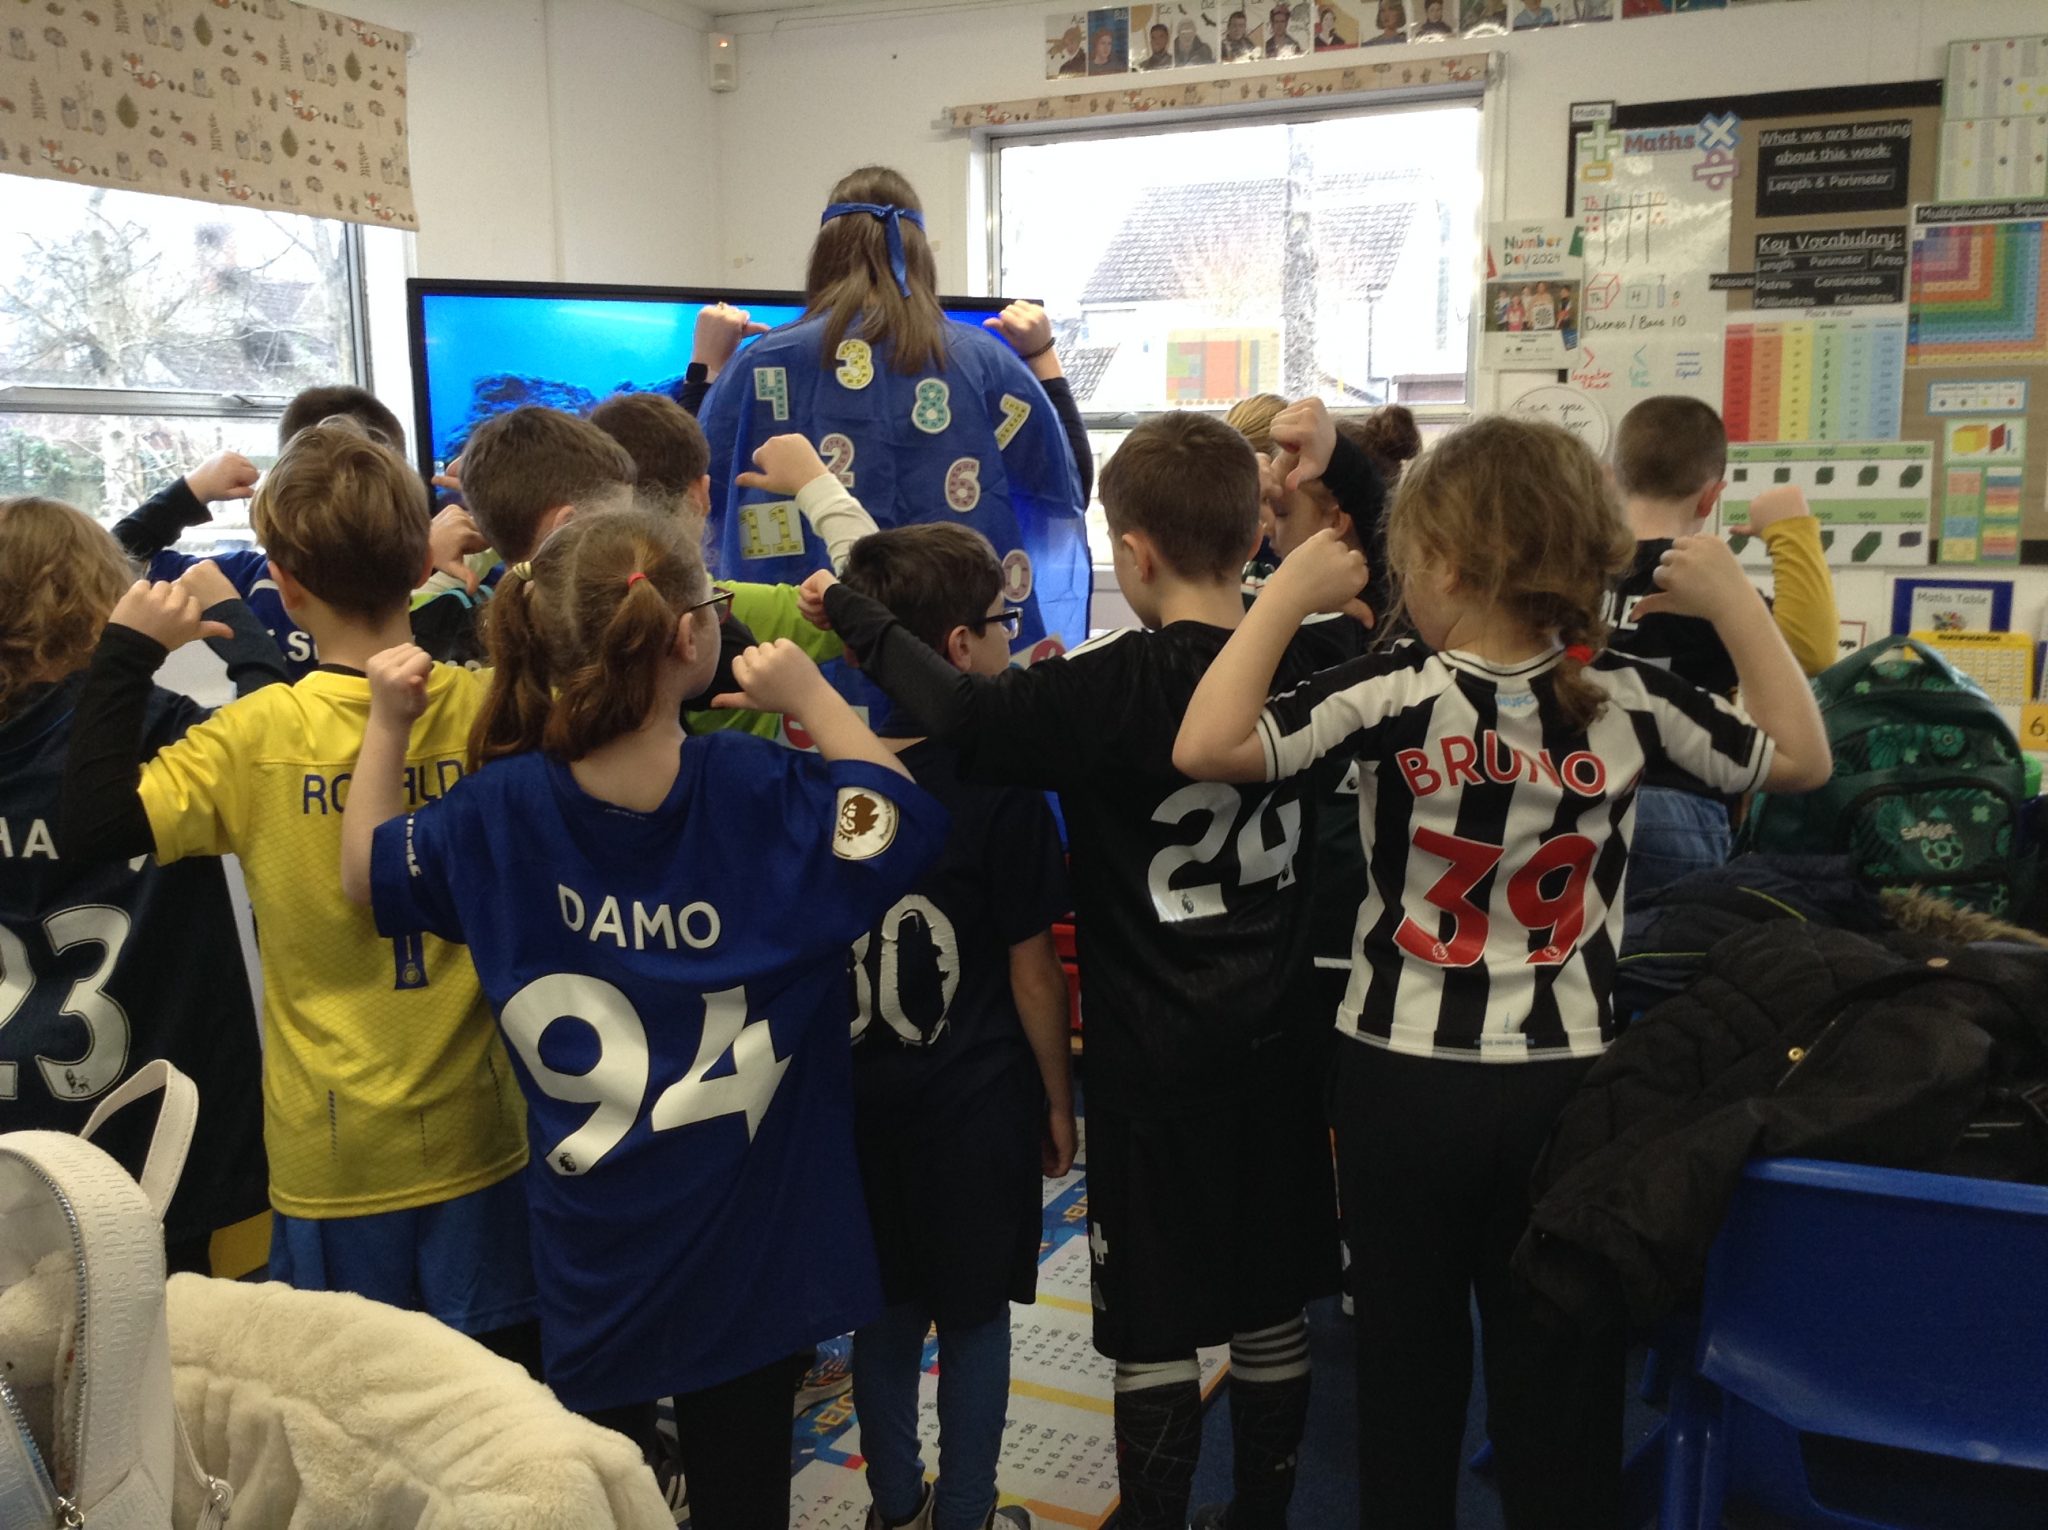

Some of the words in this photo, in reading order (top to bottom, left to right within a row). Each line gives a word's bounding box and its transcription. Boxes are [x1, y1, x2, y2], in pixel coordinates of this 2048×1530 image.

[1624, 130, 1696, 153] Maths
[1759, 131, 1799, 146] What
[1801, 130, 1824, 143] we
[1825, 128, 1850, 142] are
[1852, 122, 1912, 139] learning
[1774, 149, 1818, 166] about
[1820, 146, 1848, 161] this
[1768, 176, 1814, 194] Length
[1829, 173, 1891, 187] Perimeter
[1504, 234, 1564, 250] Number
[1504, 251, 1531, 270] Day
[1758, 236, 1790, 257] Key
[1809, 253, 1865, 267] Perimeter
[1814, 275, 1884, 289] Centimetres
[1671, 315, 1687, 328] 10
[835, 339, 874, 389] 3
[754, 367, 789, 421] 4
[911, 378, 951, 434] 8
[994, 394, 1032, 451] 7
[820, 433, 854, 488] 2
[945, 457, 981, 512] 6
[739, 504, 803, 558] 11
[1916, 592, 1953, 603] Maths
[1395, 729, 1608, 798] BRUNO
[1147, 781, 1302, 924] 24
[557, 883, 721, 950] DAMO
[1391, 826, 1599, 968] 39
[500, 972, 793, 1176] 94
